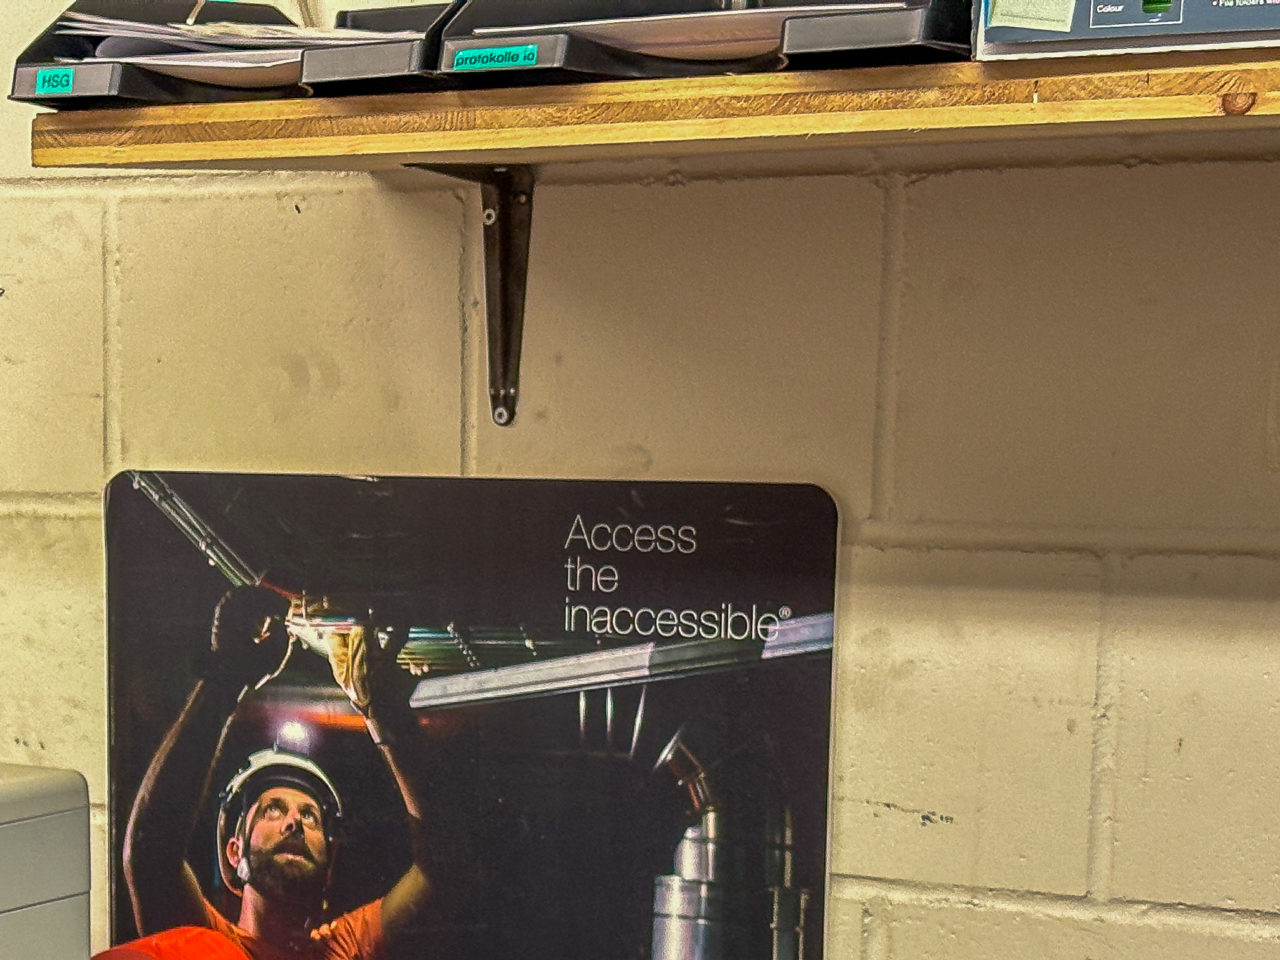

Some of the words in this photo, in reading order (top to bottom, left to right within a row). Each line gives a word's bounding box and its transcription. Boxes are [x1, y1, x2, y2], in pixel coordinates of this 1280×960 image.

[1096, 4, 1124, 14] Colour
[41, 73, 70, 89] HSG
[564, 514, 697, 553] Access
[564, 555, 619, 592] the
